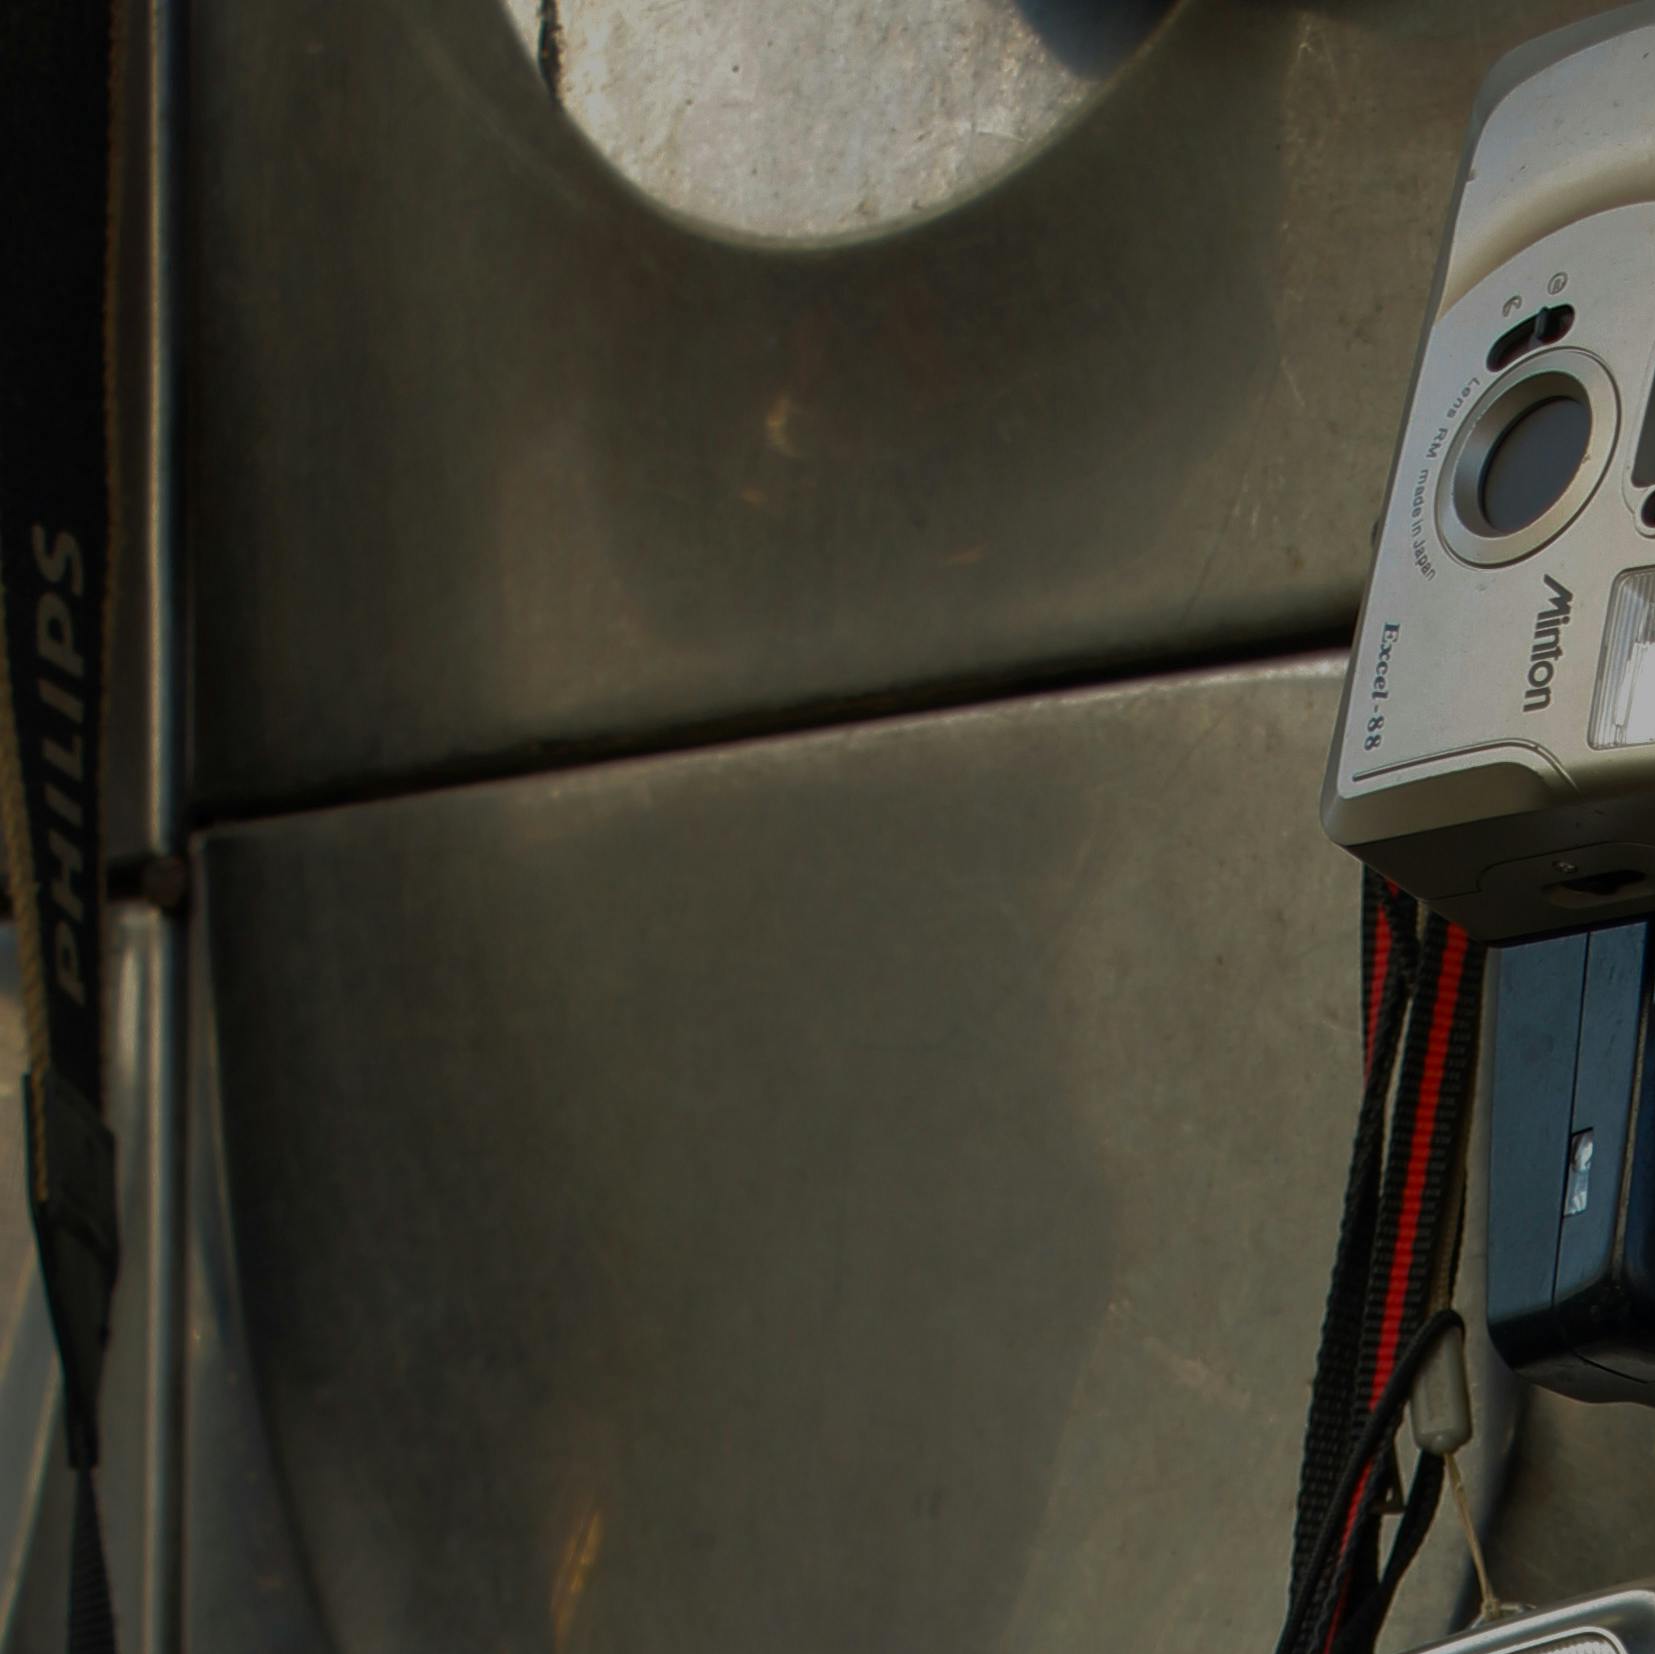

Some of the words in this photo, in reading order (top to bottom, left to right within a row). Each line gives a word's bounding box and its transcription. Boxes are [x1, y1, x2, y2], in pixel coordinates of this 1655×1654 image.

[1446, 376, 1480, 418] Lens
[1426, 427, 1448, 459] RM
[1411, 468, 1430, 518] made
[1410, 520, 1423, 537] in
[1412, 539, 1437, 582] Japan
[1524, 575, 1574, 713] Minton
[1364, 623, 1401, 751] Excel-88
[32, 527, 87, 1008] PHILIPS
